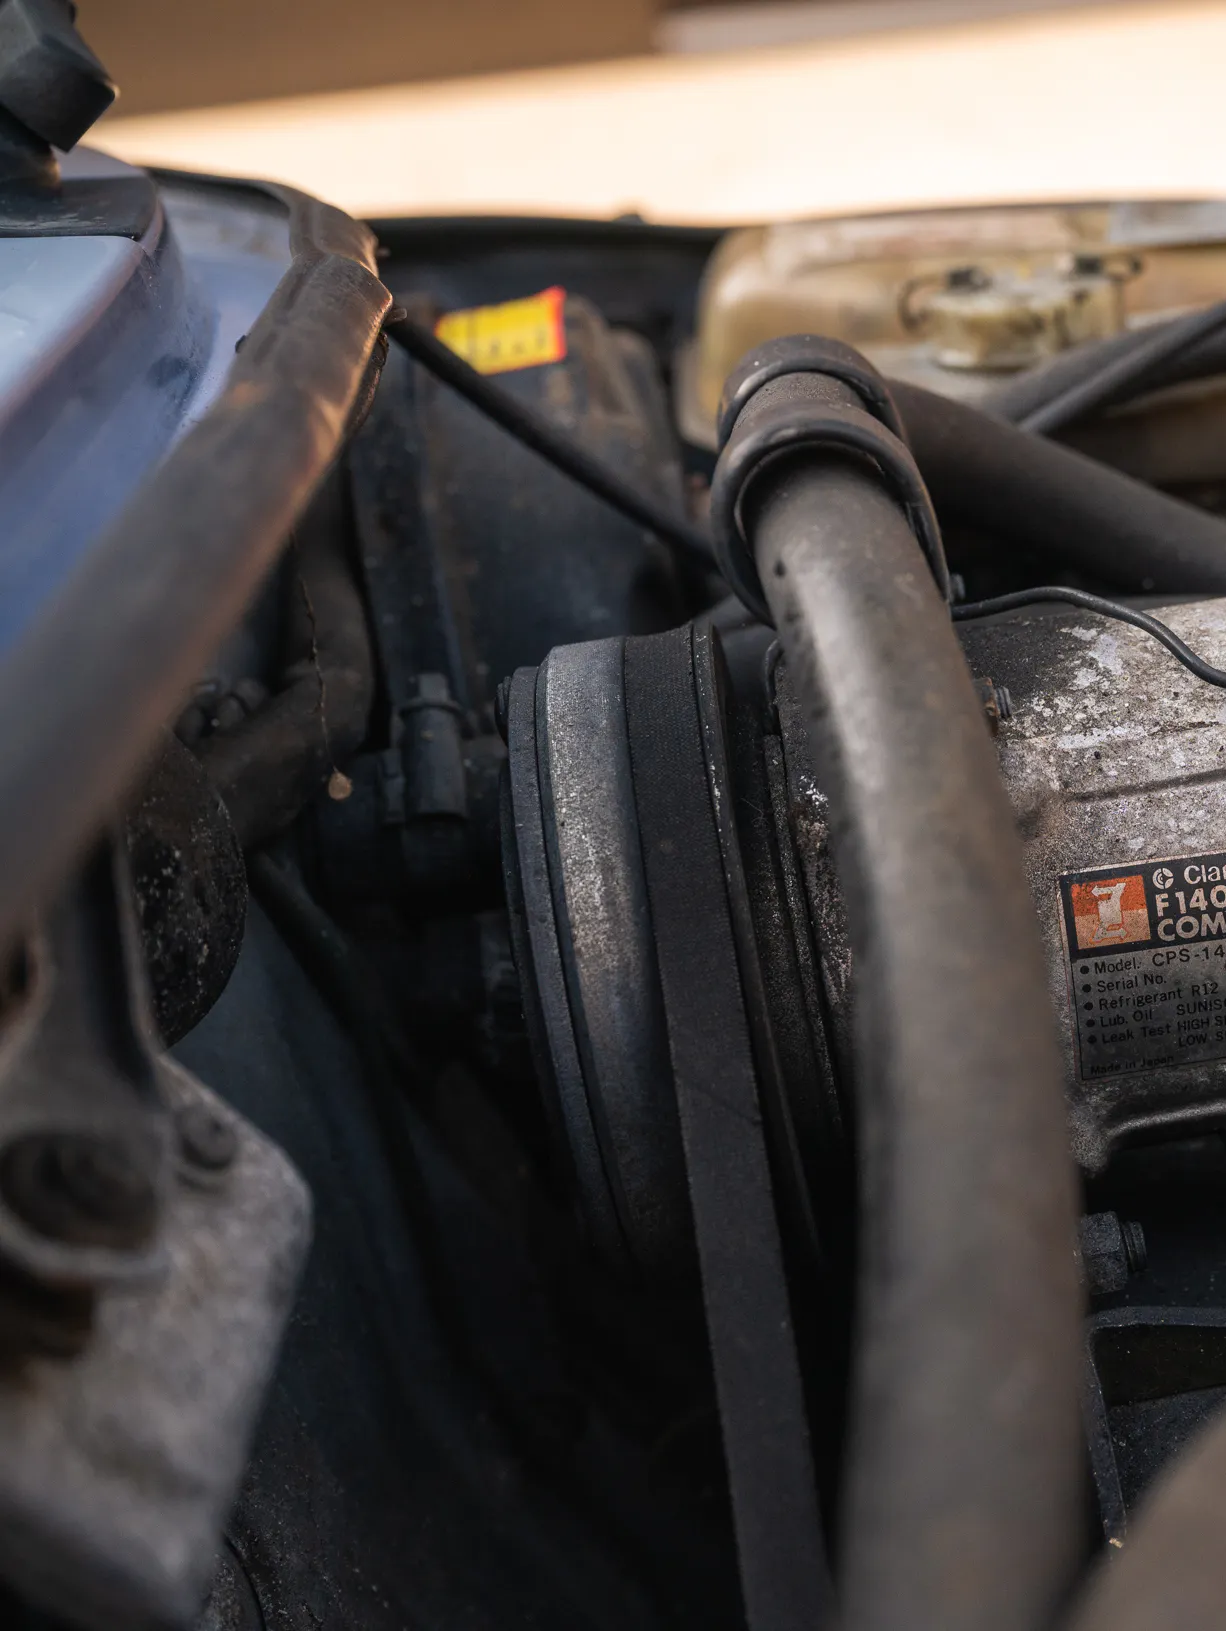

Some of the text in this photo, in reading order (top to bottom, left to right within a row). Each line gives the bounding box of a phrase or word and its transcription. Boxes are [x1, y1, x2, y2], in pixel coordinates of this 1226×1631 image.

[1097, 975, 1138, 993] Serial
[1143, 973, 1167, 986] No.
[1099, 982, 1219, 1011] Refrigerant R12
[1100, 1014, 1128, 1028] Lub.
[1132, 1010, 1153, 1023] Oil
[1102, 1029, 1135, 1044] Leak
[1140, 1022, 1172, 1038] Test
[1177, 1018, 1210, 1032] HIGH
[1178, 1033, 1208, 1048] LOW
[1090, 1055, 1174, 1076] Made in Japan
